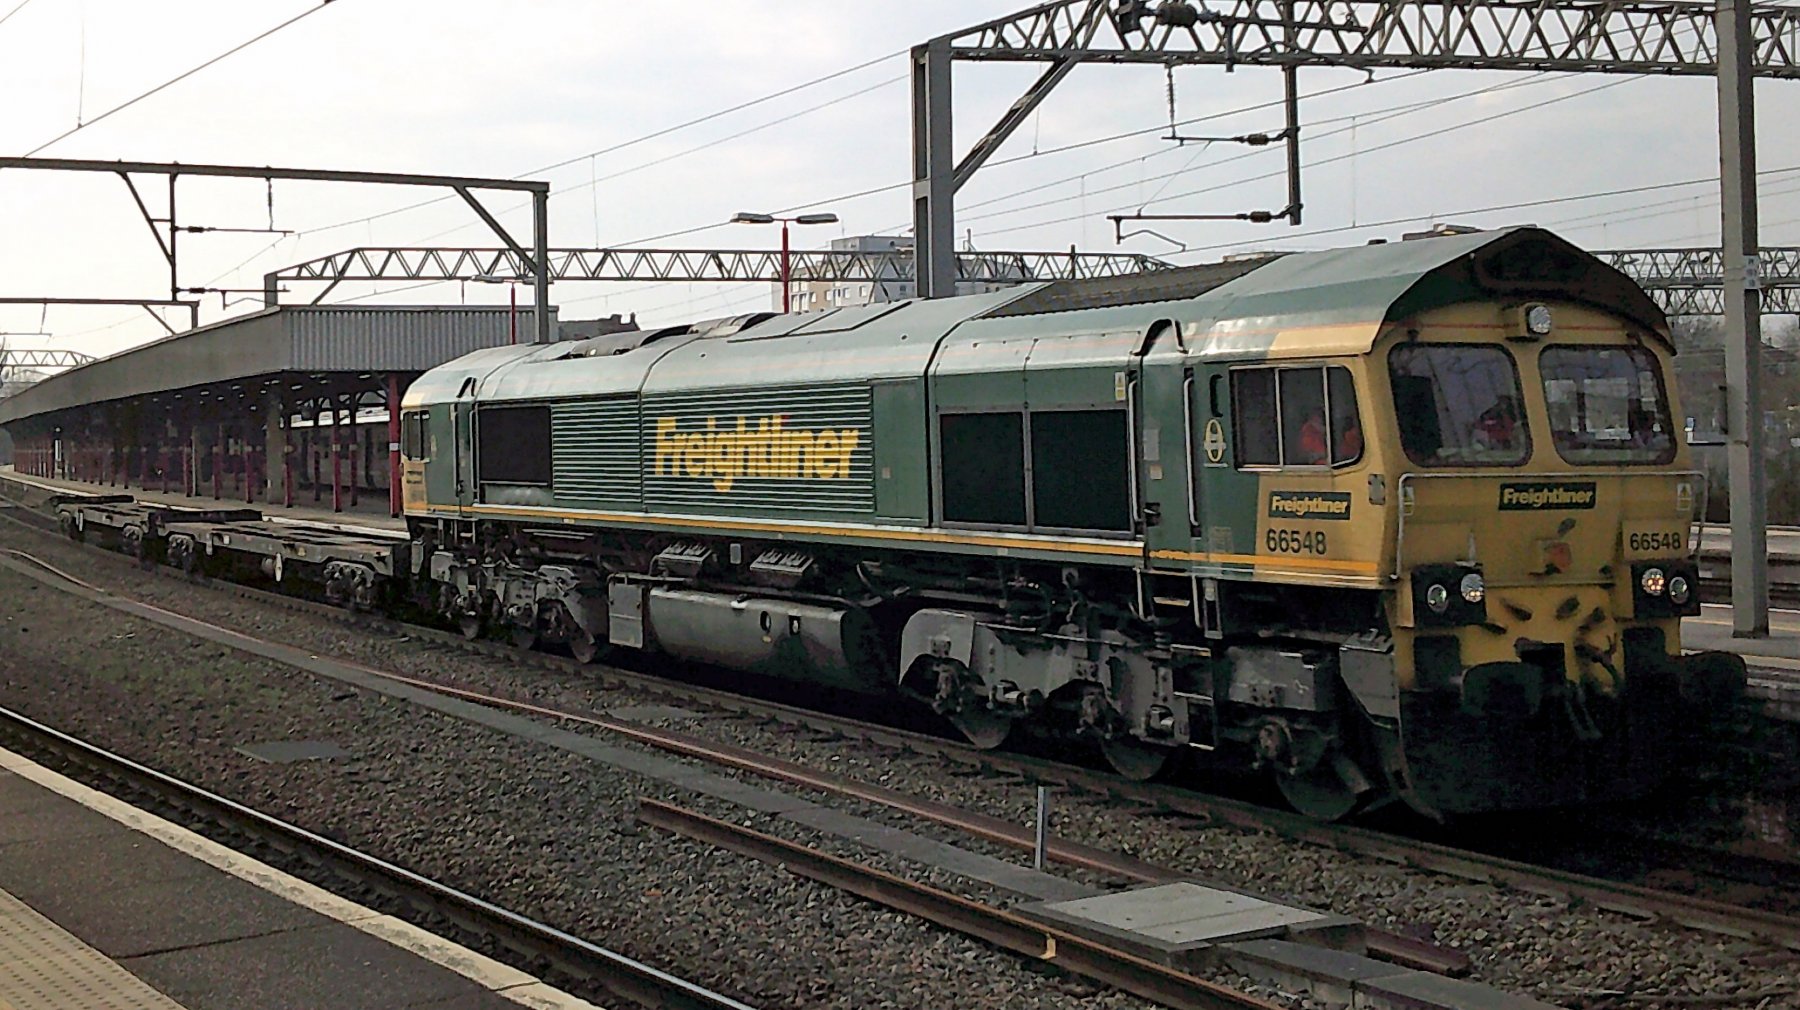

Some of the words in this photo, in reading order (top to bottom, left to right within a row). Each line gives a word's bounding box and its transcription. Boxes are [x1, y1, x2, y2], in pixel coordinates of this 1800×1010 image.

[655, 415, 859, 492] Freightliner
[1272, 496, 1348, 515] Freightliner
[1503, 488, 1593, 507] Freightliner
[1266, 528, 1328, 555] 66548
[1629, 532, 1681, 550] 66548
